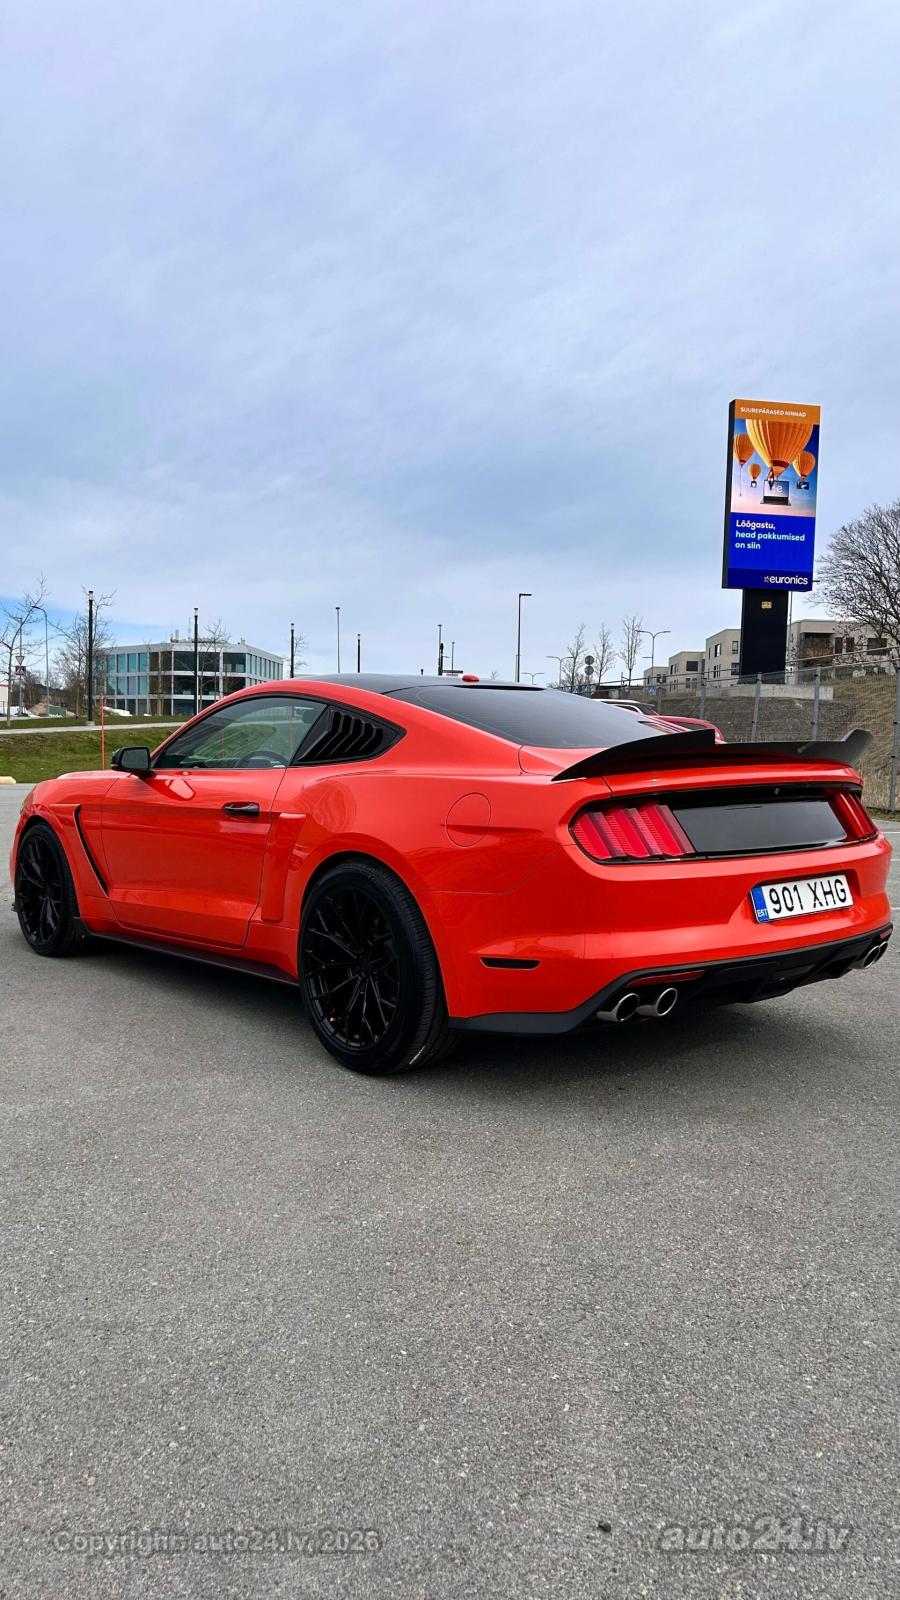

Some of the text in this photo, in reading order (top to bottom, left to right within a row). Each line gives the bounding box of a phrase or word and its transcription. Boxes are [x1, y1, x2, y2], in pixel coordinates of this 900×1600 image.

[735, 530, 806, 541] head pakkumised
[769, 575, 808, 585] euronics
[769, 879, 847, 914] 901 XHG
[756, 909, 768, 918] EST
